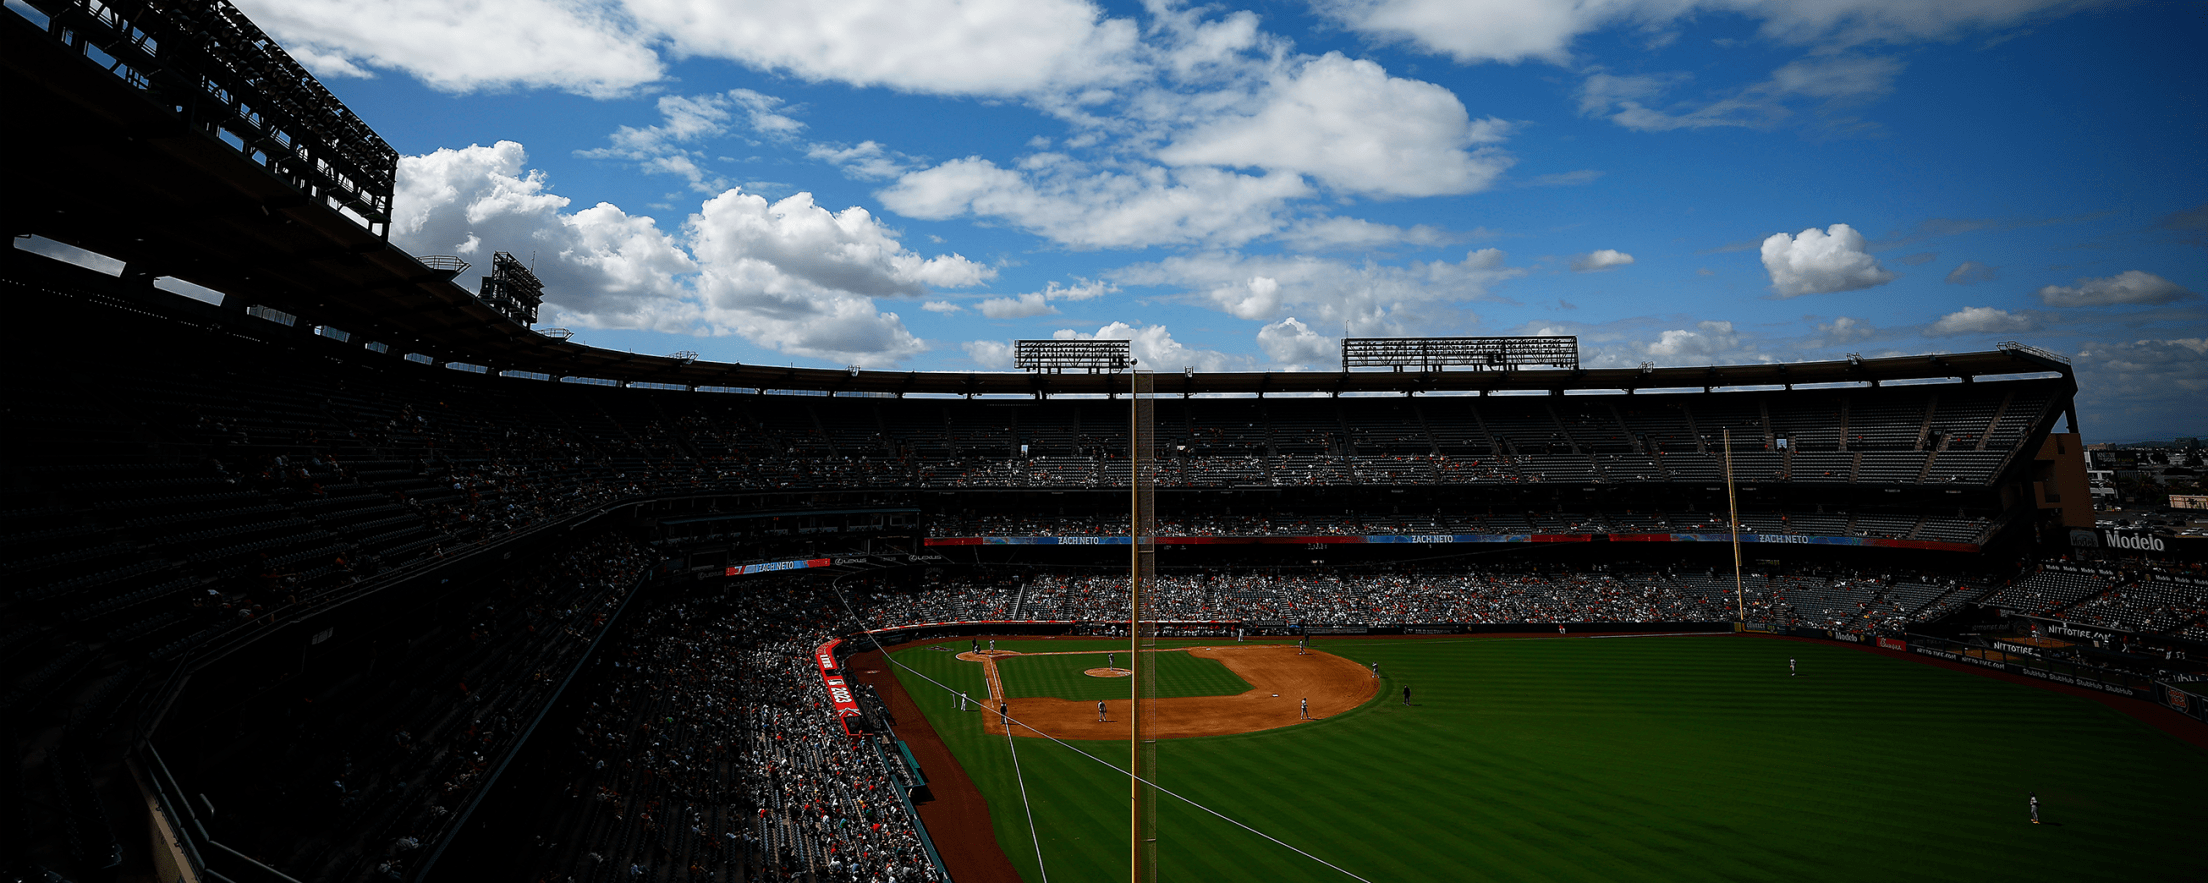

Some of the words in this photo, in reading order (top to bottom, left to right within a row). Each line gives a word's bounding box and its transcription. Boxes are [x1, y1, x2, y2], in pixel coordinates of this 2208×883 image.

[1058, 537, 1078, 545] ZACH
[1080, 537, 1099, 545] NETO
[1412, 535, 1432, 543] ZACH
[1433, 535, 1453, 543] NETO
[1759, 534, 1782, 543] ZACH
[1784, 535, 1808, 544] NETO
[2105, 529, 2166, 551] Modelo
[759, 562, 775, 572] ZACH
[776, 561, 794, 570] NETO
[1835, 631, 1858, 643] Modelo
[2022, 668, 2047, 679] StubHub
[2048, 673, 2075, 684] StubHub
[2076, 678, 2103, 690] StubHub
[2104, 684, 2133, 696] StubHub
[830, 687, 853, 703] 2023
